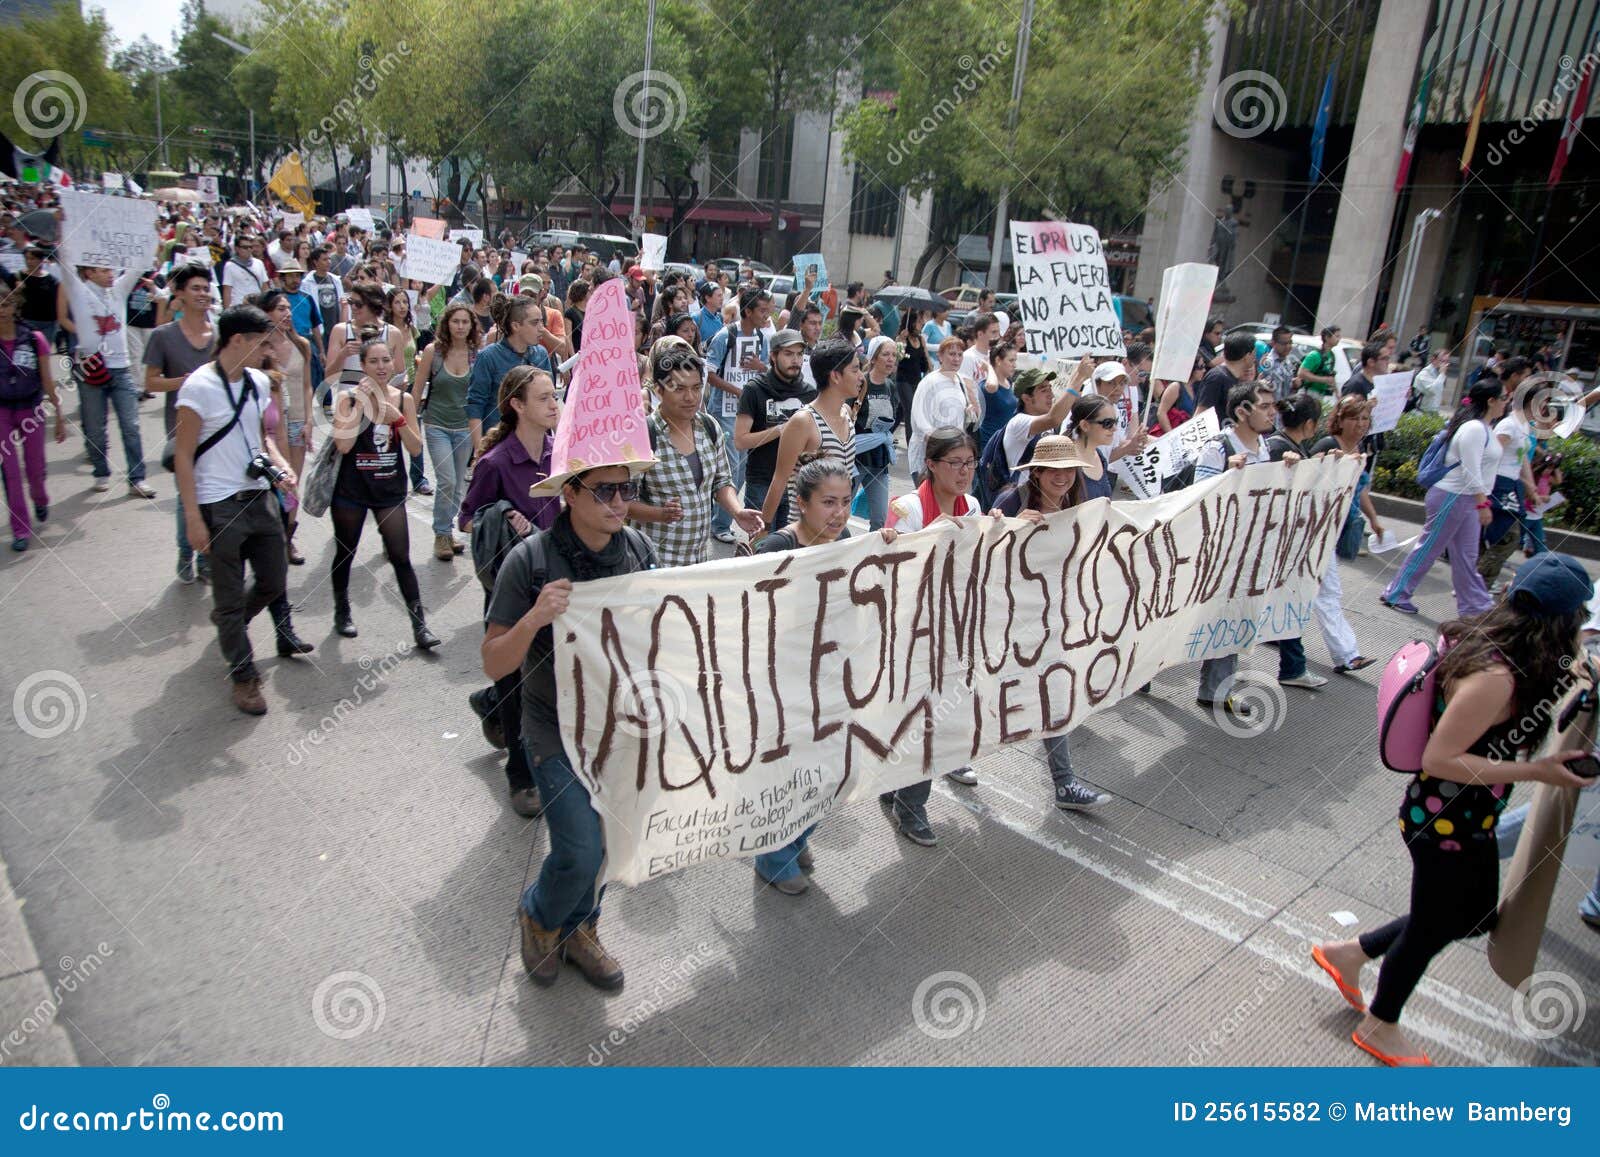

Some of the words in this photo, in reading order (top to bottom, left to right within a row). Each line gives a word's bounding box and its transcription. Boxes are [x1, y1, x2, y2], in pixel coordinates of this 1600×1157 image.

[1018, 265, 1043, 290] LA
[1050, 261, 1108, 288] FUERZ
[1022, 297, 1049, 321] NO
[1060, 294, 1078, 316] A
[1081, 291, 1111, 312] LA
[1025, 323, 1123, 354] IMPOSICIÓ
[810, 523, 1050, 742] ESTAMOS
[1060, 519, 1139, 650] LOS
[1129, 518, 1190, 631] QUE
[1185, 492, 1239, 608] NO
[802, 786, 818, 802] de
[645, 803, 729, 841] Facultad
[734, 797, 755, 817] de
